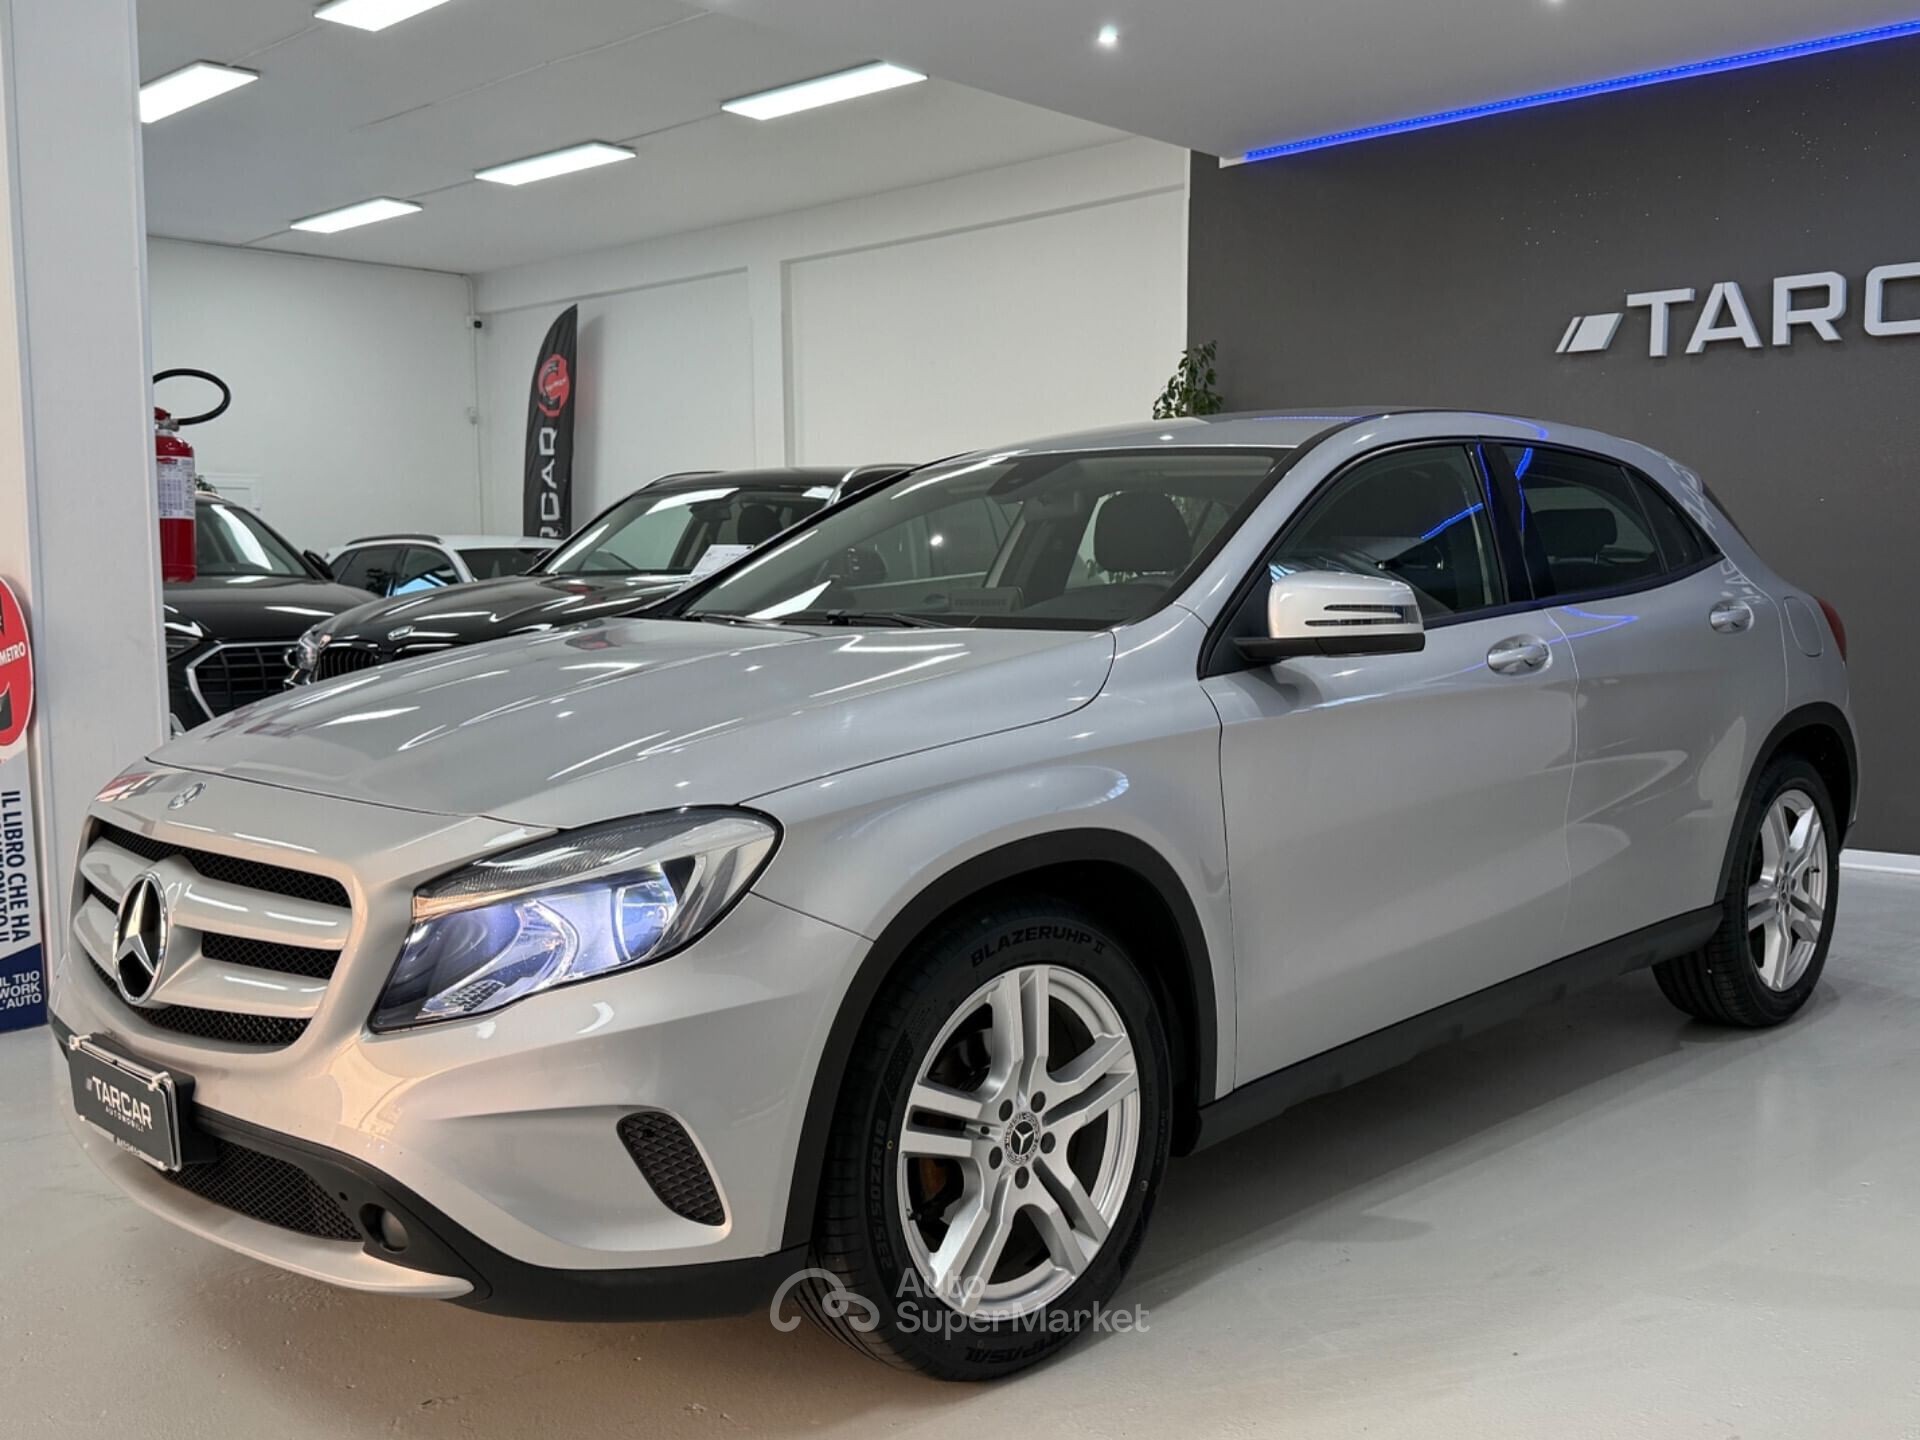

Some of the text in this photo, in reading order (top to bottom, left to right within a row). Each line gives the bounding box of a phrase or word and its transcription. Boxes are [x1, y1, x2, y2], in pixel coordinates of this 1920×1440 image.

[1626, 261, 1920, 358] TARC
[1, 791, 21, 808] IL
[3, 811, 26, 868] LIBRO
[8, 872, 29, 911] CHE
[11, 914, 31, 943] HA
[12, 970, 40, 984] TUO
[92, 1076, 153, 1129] TARCAR
